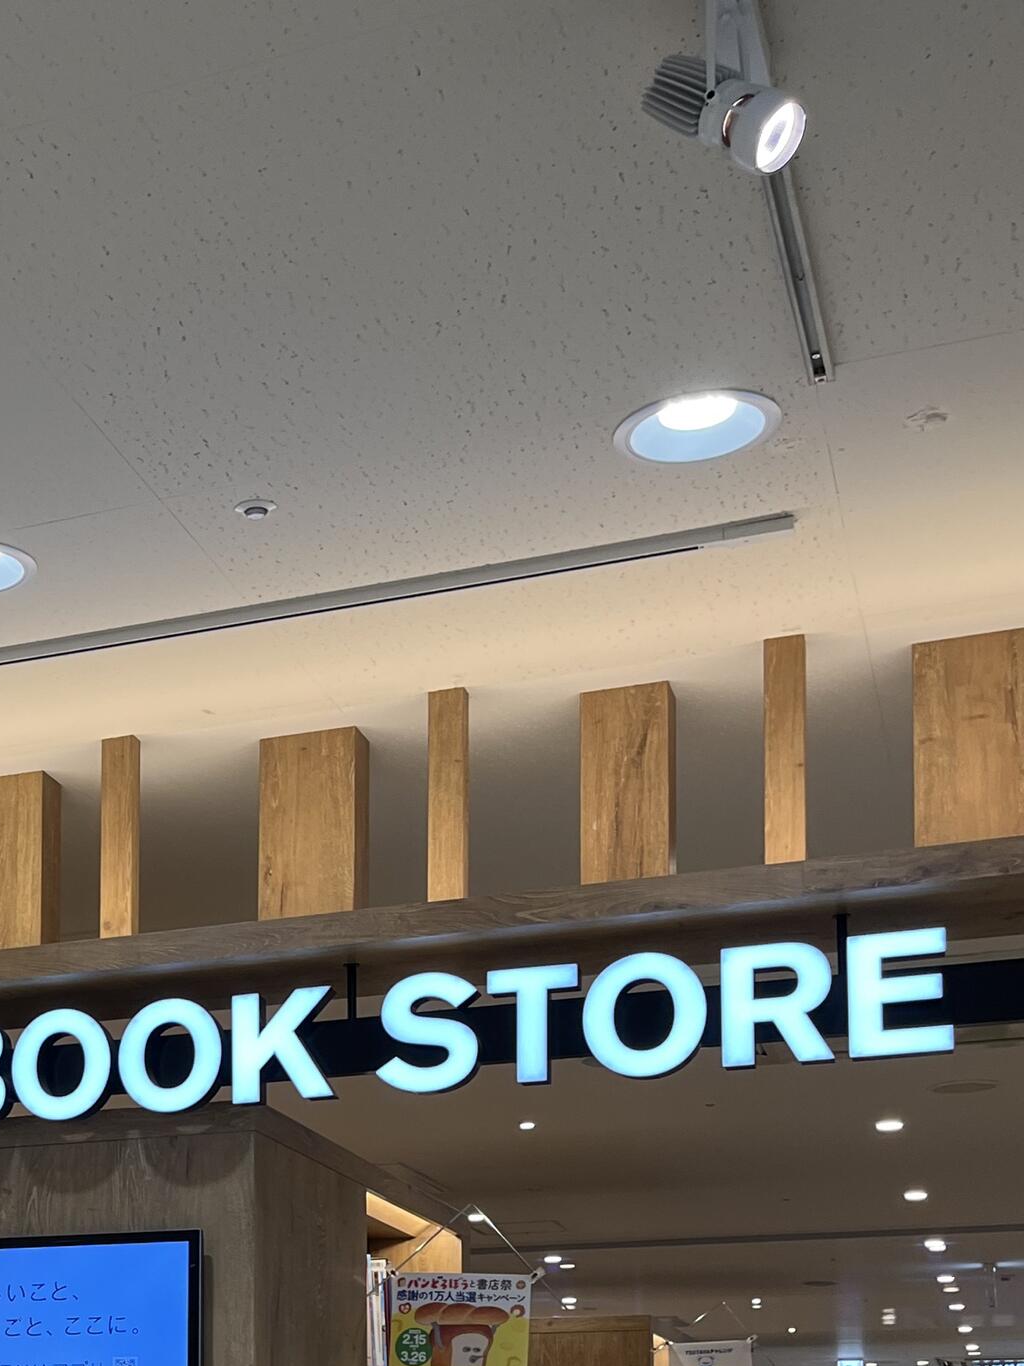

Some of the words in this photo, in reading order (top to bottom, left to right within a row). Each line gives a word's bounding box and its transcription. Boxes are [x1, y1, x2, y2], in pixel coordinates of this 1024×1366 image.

[376, 926, 954, 1094] STORE
[407, 1276, 512, 1291] パンどろぼうと書店祭
[397, 1290, 526, 1303] 感謝の1万人当選キャンペーン
